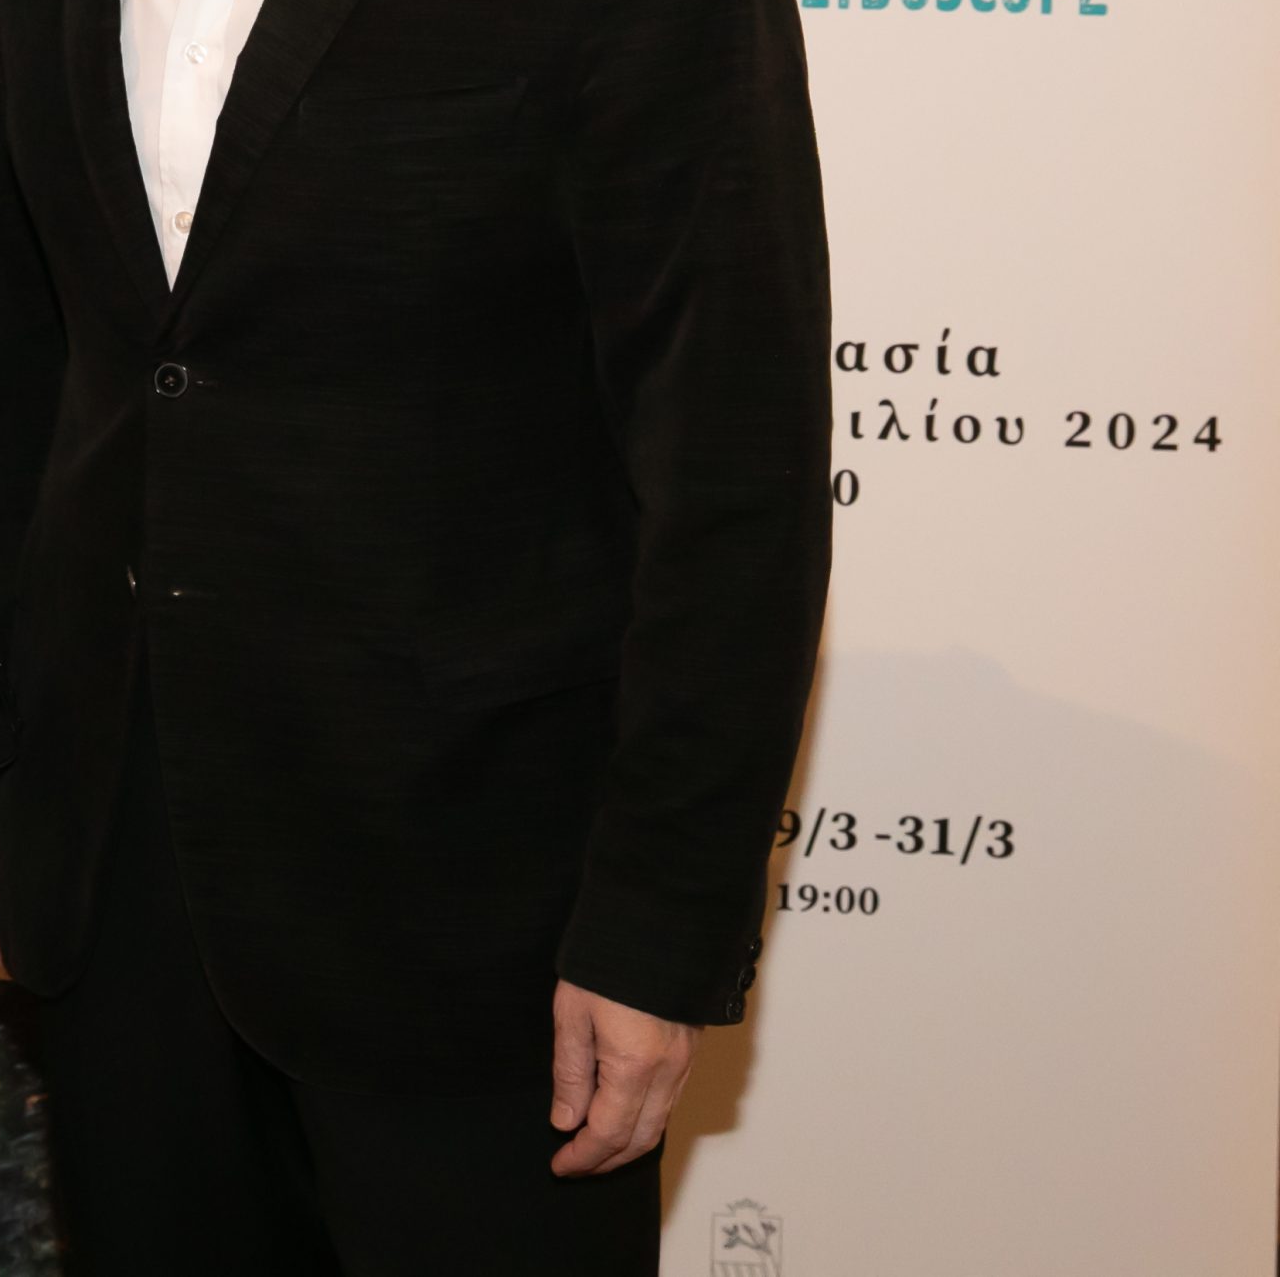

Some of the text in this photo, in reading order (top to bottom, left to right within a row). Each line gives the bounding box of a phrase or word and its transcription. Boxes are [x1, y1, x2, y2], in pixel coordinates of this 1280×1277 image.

[834, 328, 1001, 377] ασία
[849, 398, 1223, 452] ιλίου 2024
[832, 469, 860, 507] 0
[776, 807, 858, 857] 9/3
[776, 883, 880, 916] 19:00
